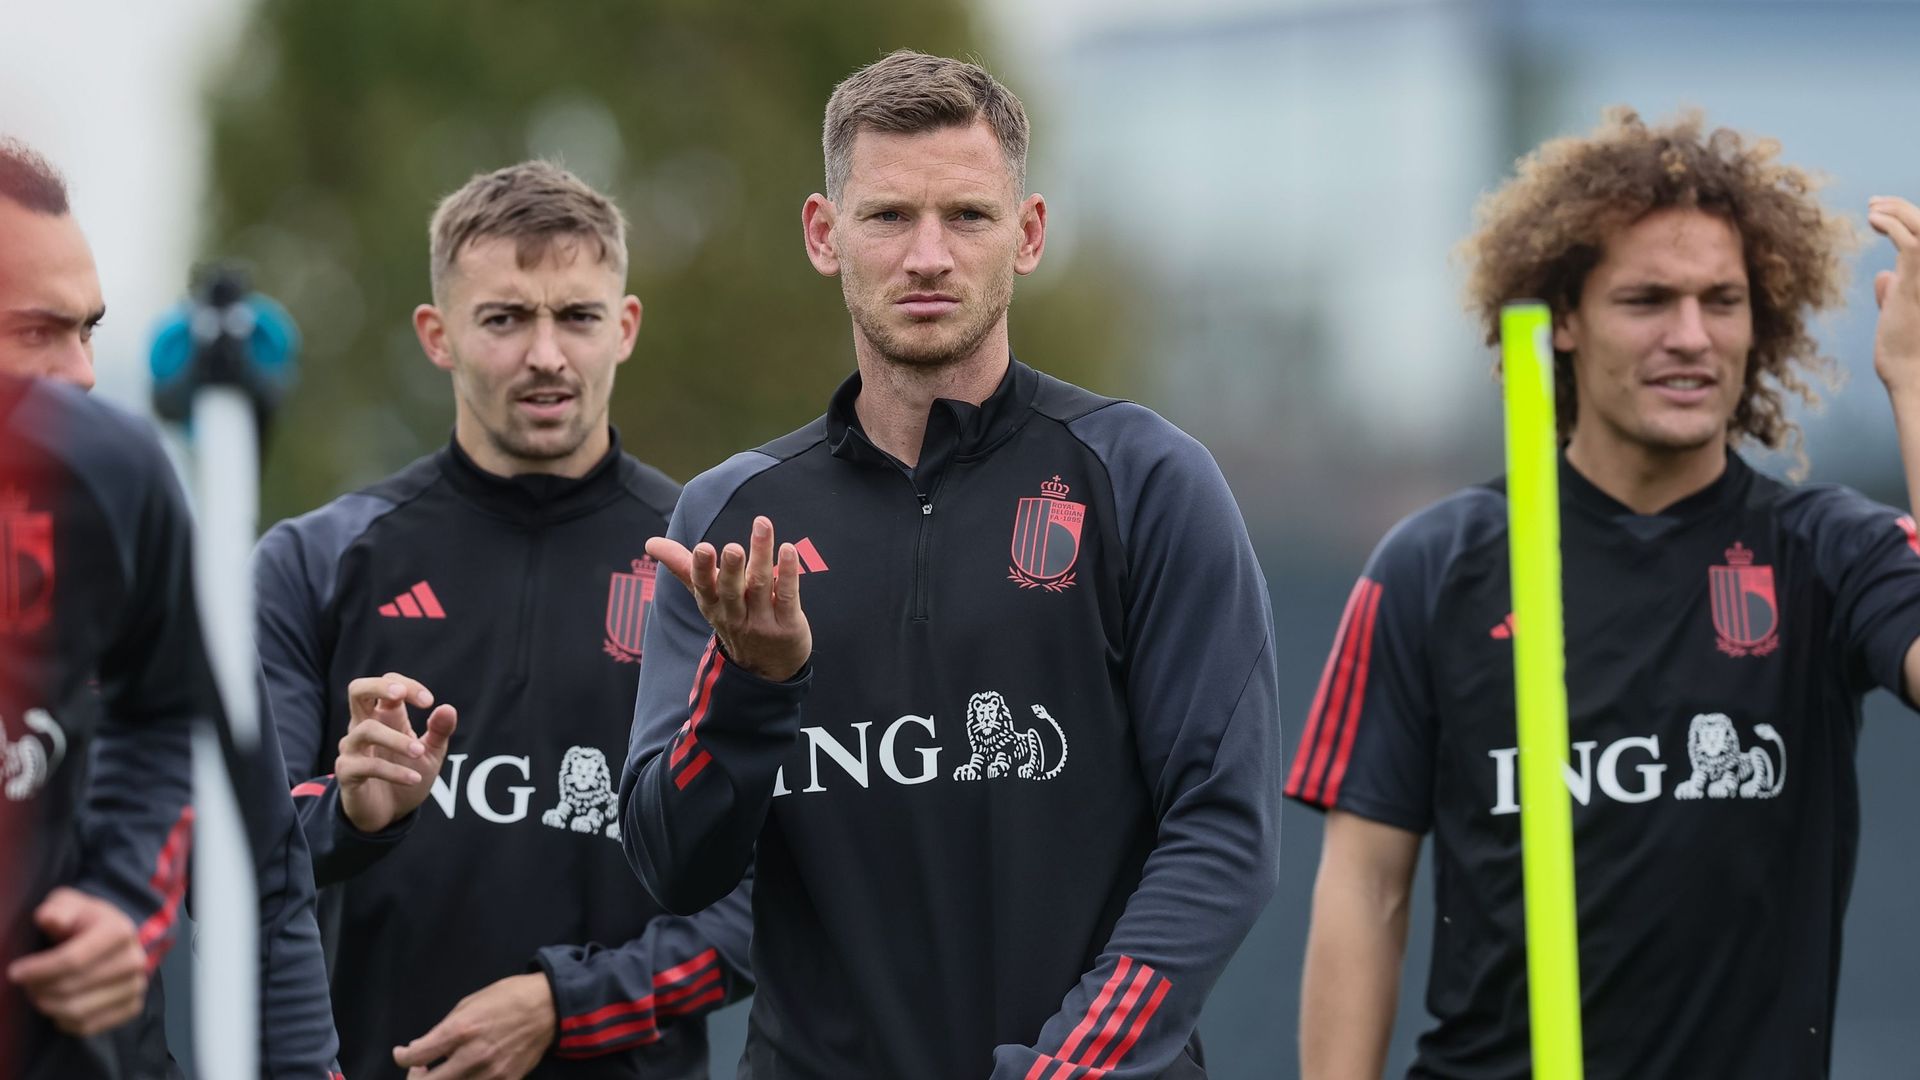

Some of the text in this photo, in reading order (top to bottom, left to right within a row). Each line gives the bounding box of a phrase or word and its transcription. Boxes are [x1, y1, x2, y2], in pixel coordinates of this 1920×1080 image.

[1052, 502, 1075, 510] ROYAL
[1051, 508, 1083, 517] BELGIAN
[430, 753, 536, 824] NG
